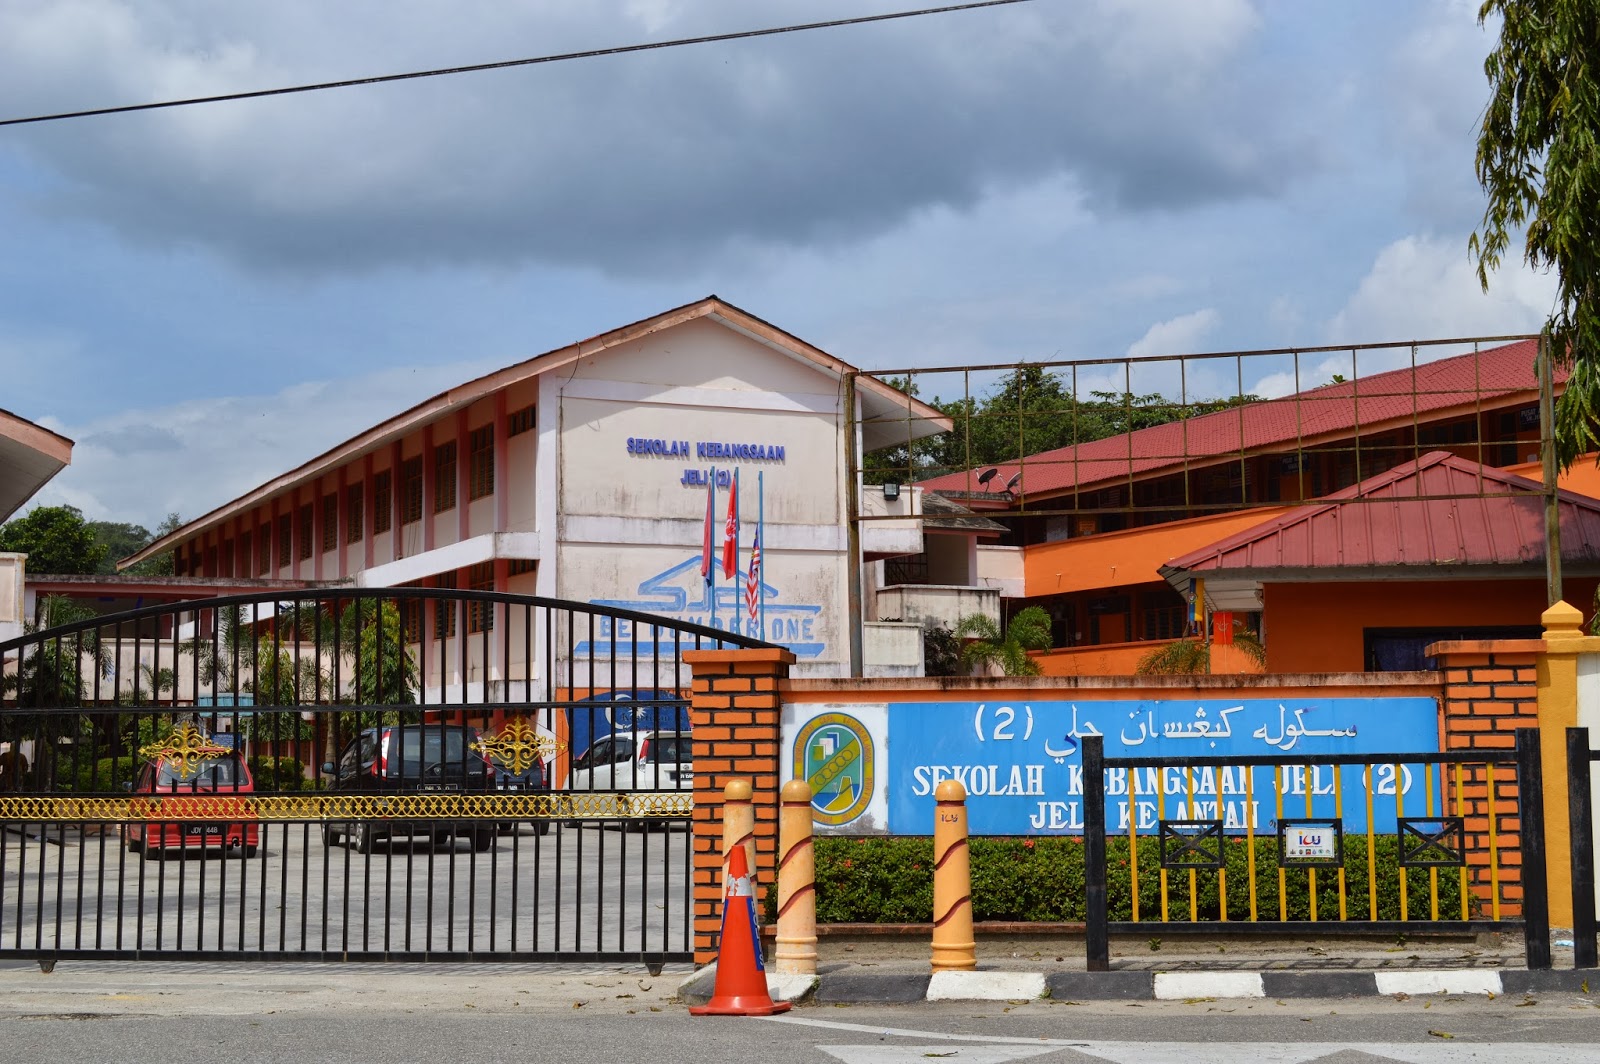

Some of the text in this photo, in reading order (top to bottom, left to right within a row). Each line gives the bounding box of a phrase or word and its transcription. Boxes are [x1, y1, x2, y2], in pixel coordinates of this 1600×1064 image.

[626, 436, 785, 461] SEKOLAH KEBANGSAAN
[680, 469, 731, 487] JELI (2)
[600, 615, 631, 638] BE
[771, 618, 814, 641] ONE
[911, 764, 1045, 796] SEKOLAH
[1067, 763, 1255, 796] KBANGSAAN
[1362, 763, 1413, 795] (2)
[1029, 801, 1259, 829] JEL KEANTAN
